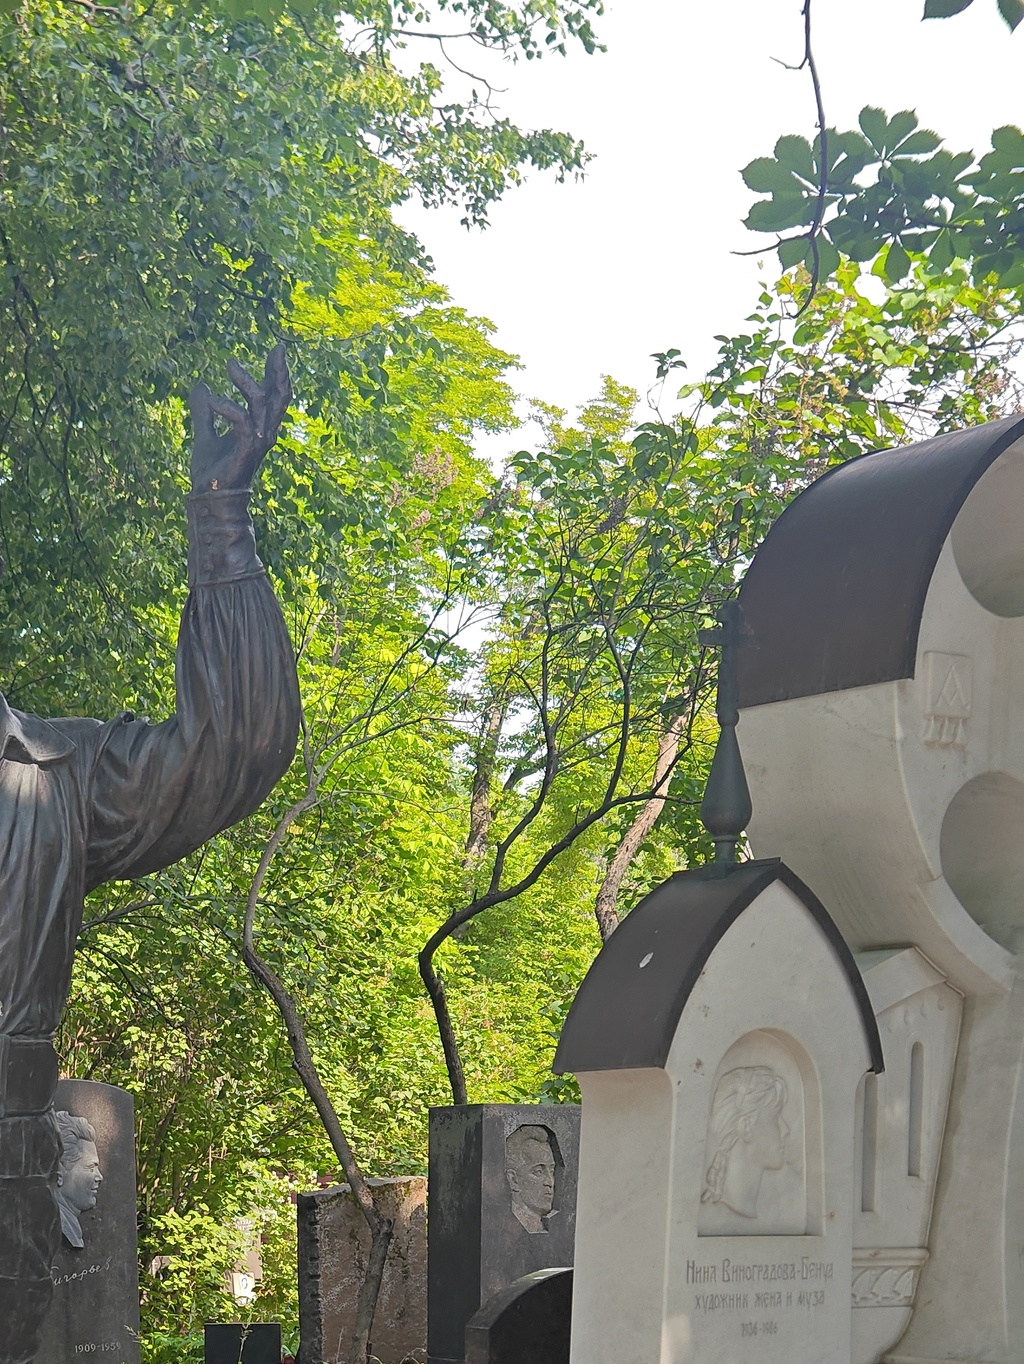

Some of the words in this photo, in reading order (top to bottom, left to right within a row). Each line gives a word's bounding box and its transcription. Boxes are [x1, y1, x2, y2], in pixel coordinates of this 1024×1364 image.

[686, 1260, 717, 1284] Нина
[722, 1256, 834, 1286] Виноградова-Бенуа
[694, 1293, 749, 1315] художник
[754, 1291, 782, 1308] жена
[786, 1291, 793, 1306] и
[796, 1290, 826, 1313] муза
[75, 1342, 121, 1354] 1909-1959
